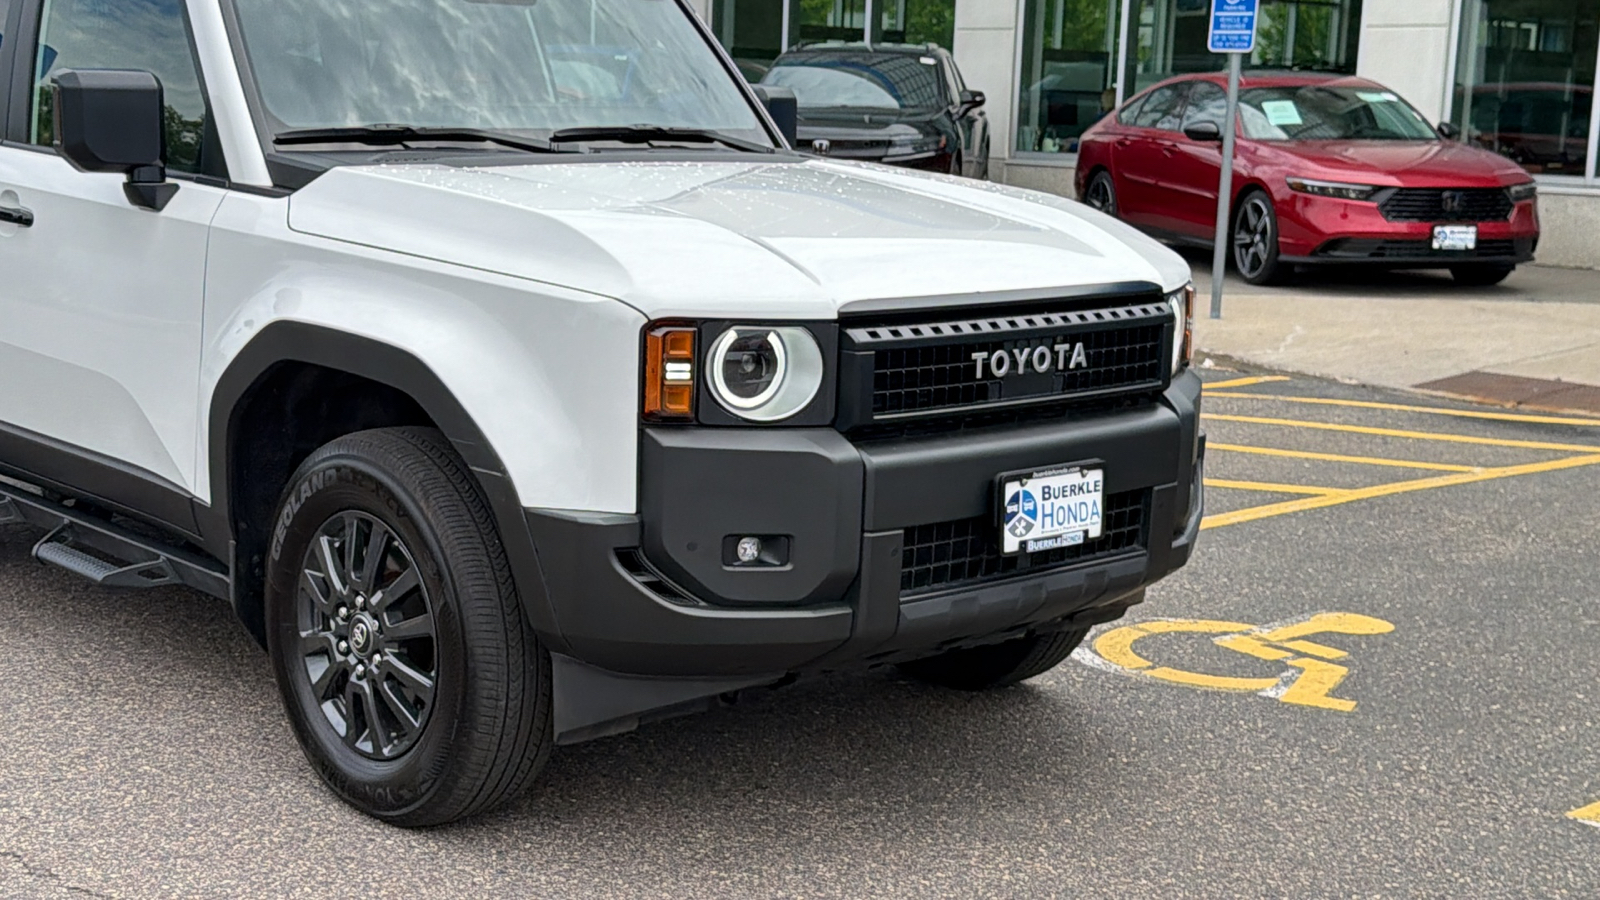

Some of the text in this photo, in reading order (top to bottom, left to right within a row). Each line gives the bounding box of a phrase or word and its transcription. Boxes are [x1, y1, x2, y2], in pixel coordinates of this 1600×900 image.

[971, 342, 1088, 379] TOYOTA
[1041, 480, 1101, 501] BUERKLE
[1041, 500, 1101, 529] HONDA
